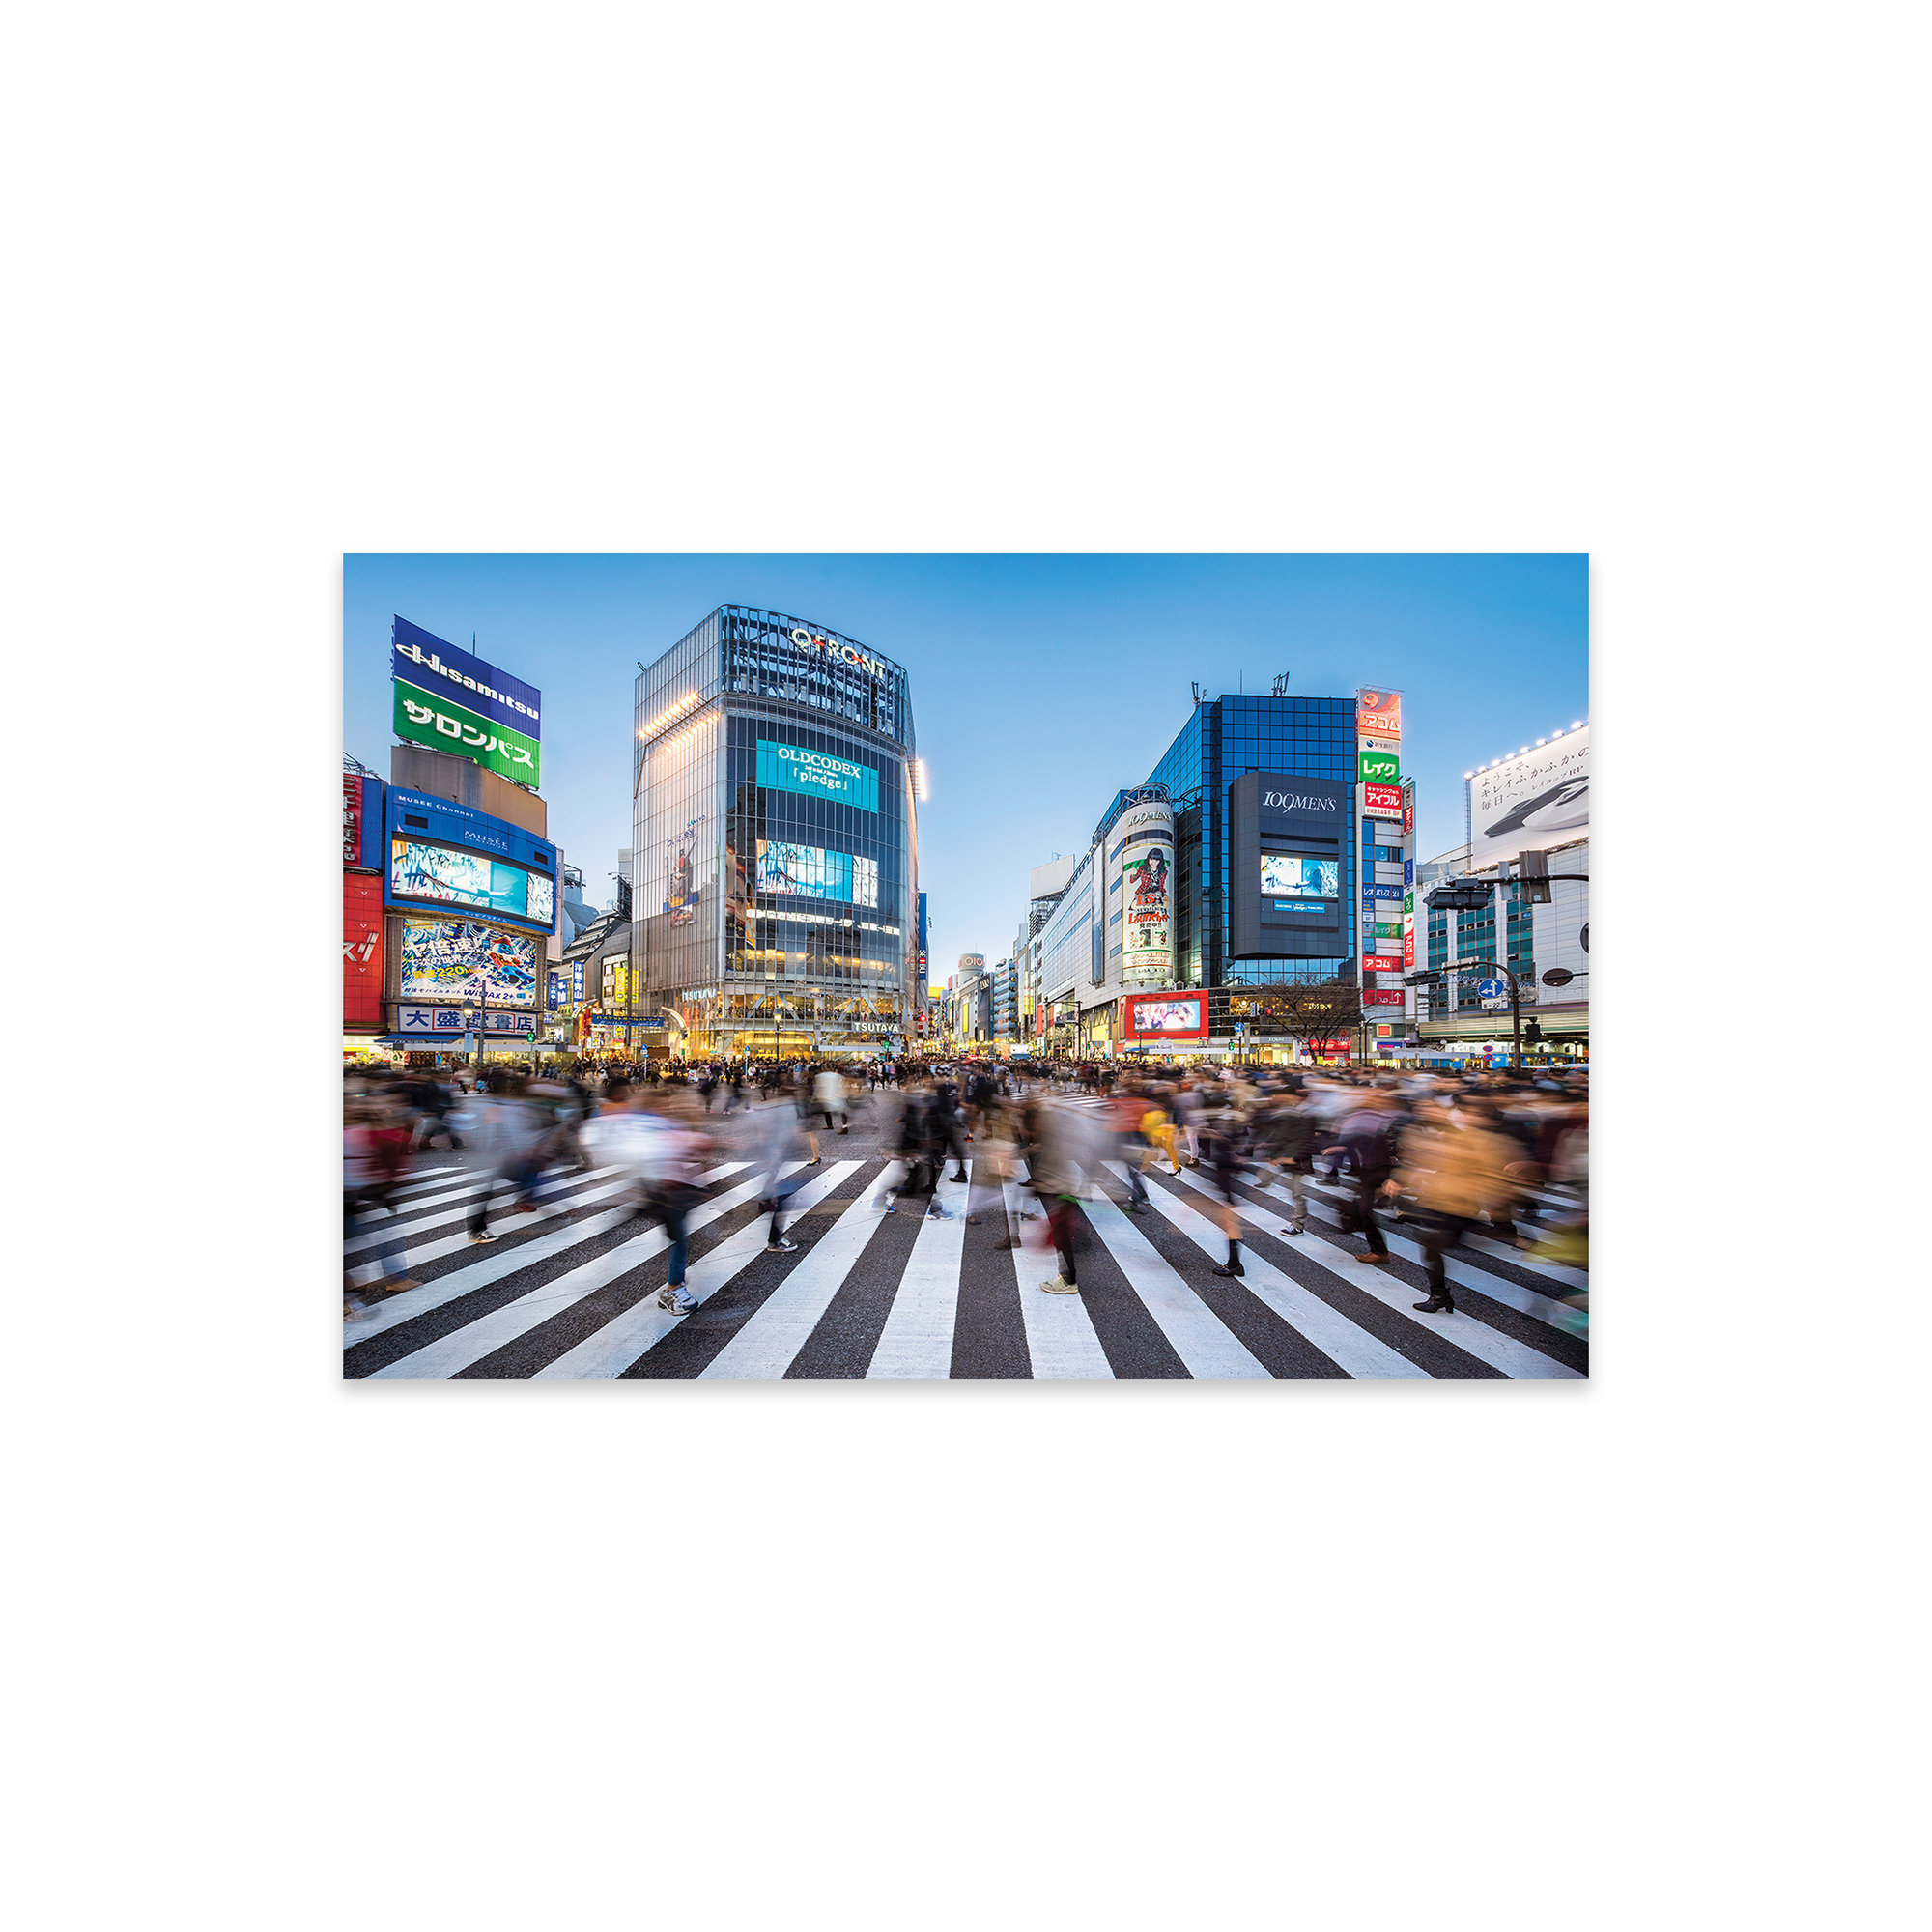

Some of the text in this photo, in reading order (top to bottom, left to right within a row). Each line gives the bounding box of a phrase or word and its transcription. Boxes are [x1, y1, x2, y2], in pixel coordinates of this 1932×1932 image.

[791, 628, 886, 679] QFRONT
[1364, 714, 1401, 732] アコム
[403, 699, 534, 769] サロンパス
[778, 748, 862, 779] OLDCODEX
[1363, 759, 1396, 777] レイク
[398, 795, 474, 818] MUSEE Channel
[1367, 792, 1400, 806] アイフル
[1365, 958, 1391, 970] アコム
[464, 989, 500, 999] WiAX
[854, 1023, 899, 1033] TSUTAYA
